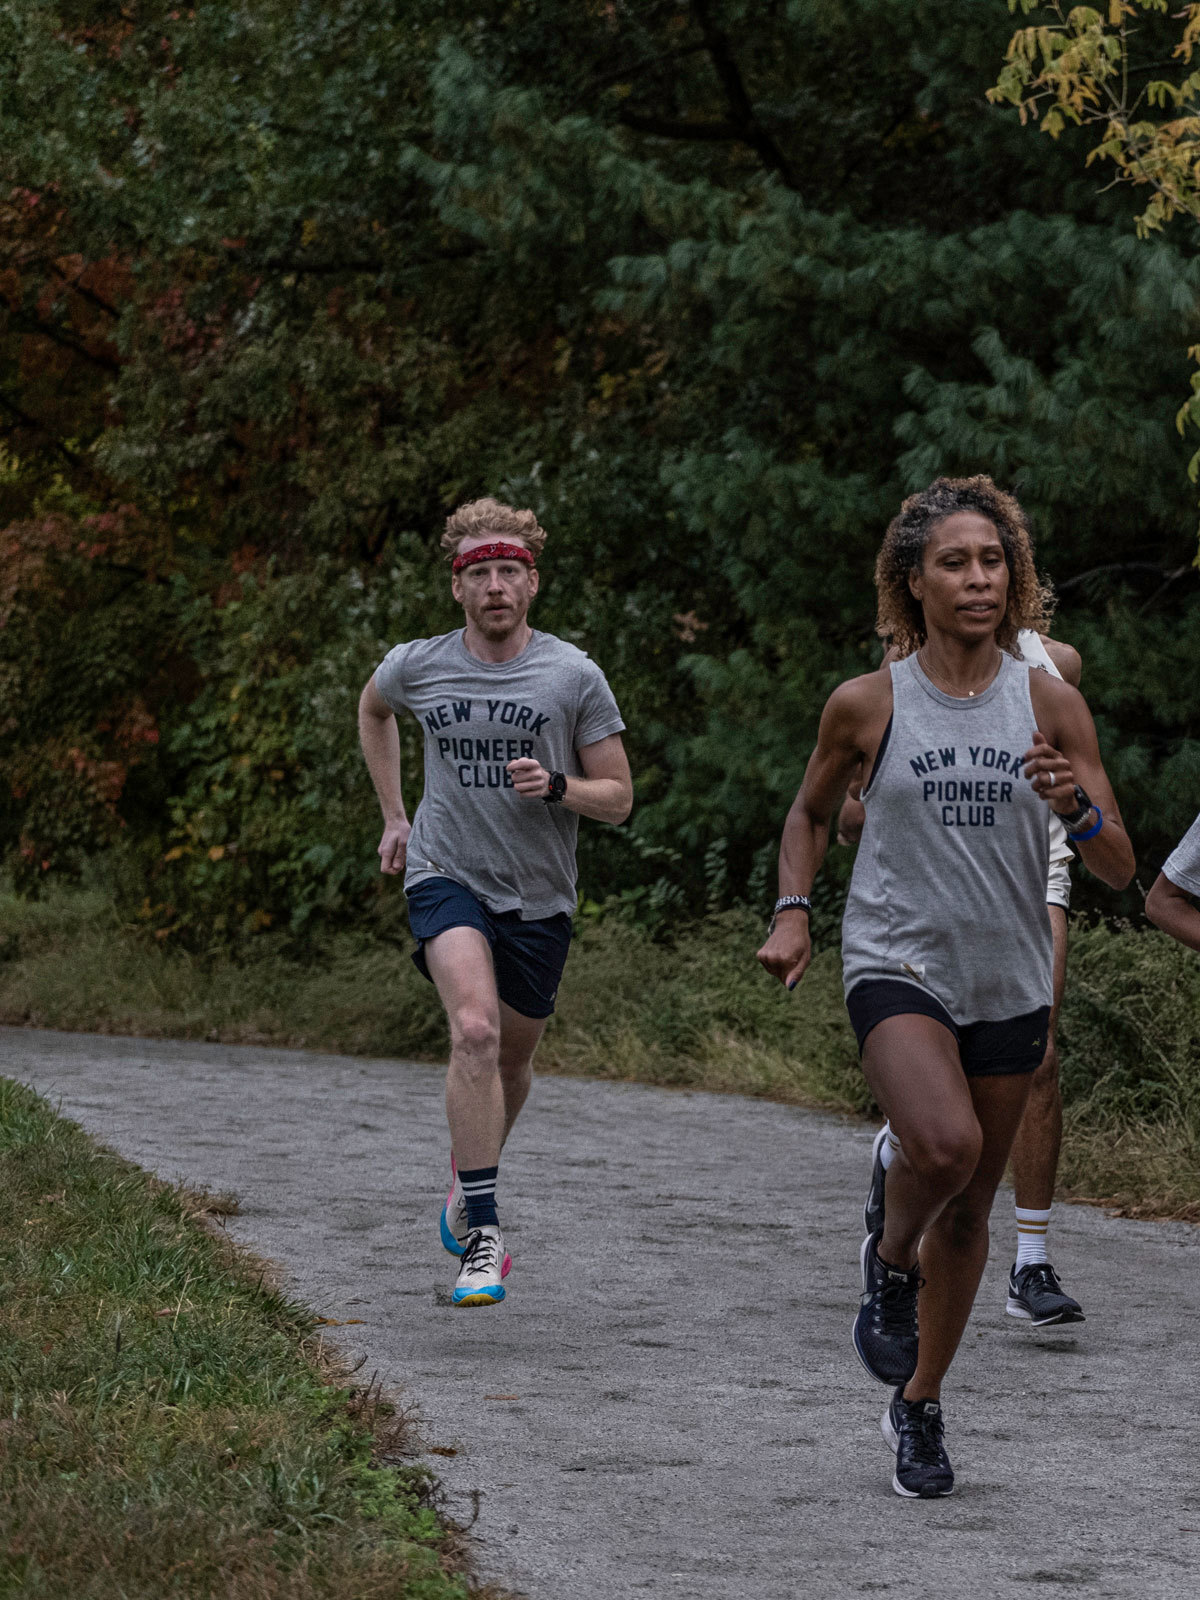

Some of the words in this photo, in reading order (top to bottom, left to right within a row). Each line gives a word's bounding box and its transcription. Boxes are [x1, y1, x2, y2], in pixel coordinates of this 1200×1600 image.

[425, 700, 472, 735] NEW
[487, 700, 550, 736] YORK
[438, 737, 534, 762] PIONEER
[909, 747, 956, 778] NEW
[968, 746, 1025, 779] YORK
[923, 781, 1013, 803] PIONEER
[942, 806, 995, 827] CLUB
